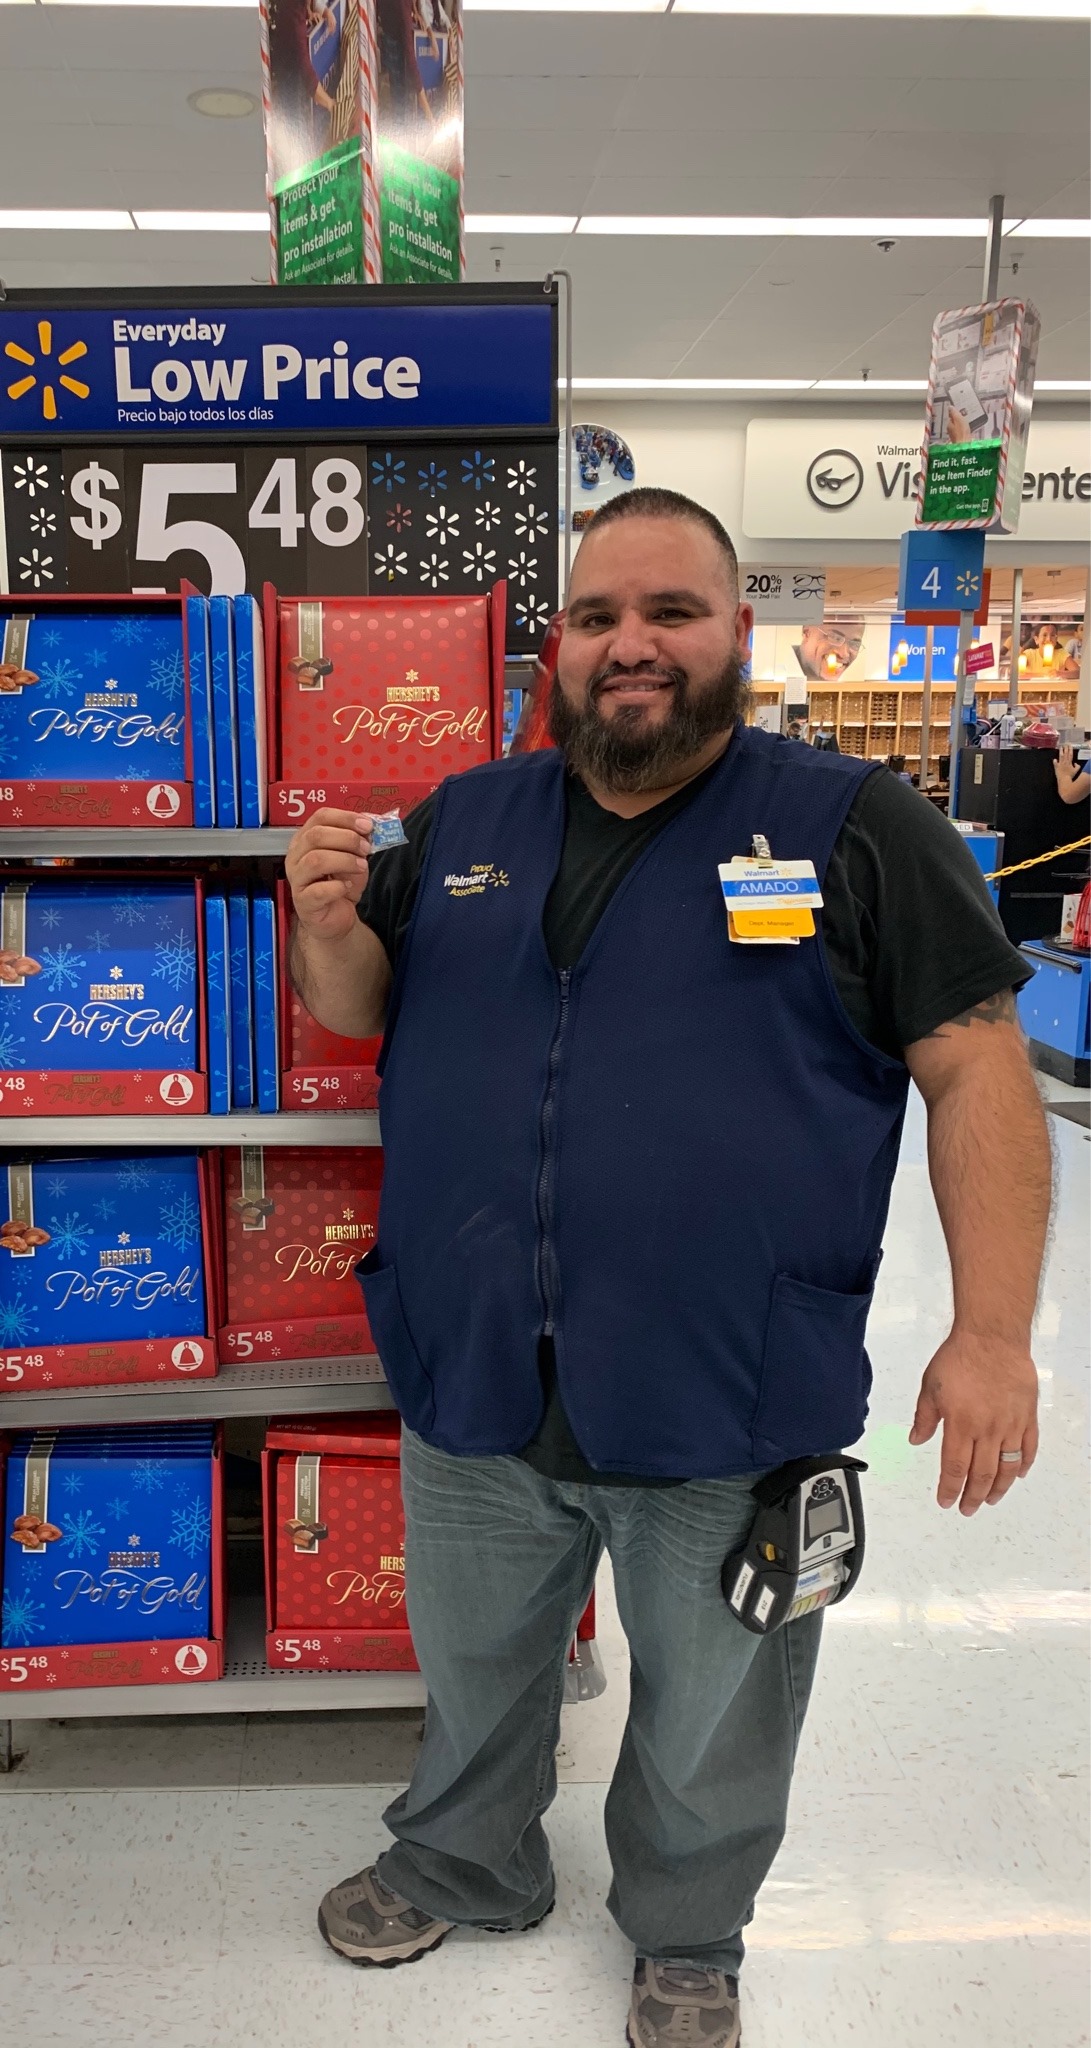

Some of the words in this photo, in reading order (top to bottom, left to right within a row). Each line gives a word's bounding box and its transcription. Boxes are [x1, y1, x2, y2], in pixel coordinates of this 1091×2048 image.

[282, 178, 317, 207] Protect
[318, 165, 339, 193] your
[283, 213, 308, 236] items
[310, 204, 318, 222] &
[320, 196, 336, 222] get
[388, 190, 413, 213] items
[414, 200, 422, 218] &
[423, 210, 438, 227] get
[284, 247, 299, 268] pro
[301, 220, 353, 255] installation
[389, 221, 405, 238] pro
[406, 224, 453, 261] installation
[284, 272, 294, 282] Ask
[294, 268, 301, 278] an
[301, 257, 327, 274] Associate
[326, 252, 335, 263] for
[389, 242, 399, 254] Ask
[406, 250, 430, 269] Associate
[429, 261, 437, 272] for
[113, 318, 226, 347] Everyday
[113, 346, 248, 403] Low
[262, 340, 421, 400] Price
[117, 408, 156, 422] Precio
[159, 407, 187, 424] bajo
[189, 407, 225, 421] todos
[228, 407, 246, 420] los
[248, 406, 274, 420] días
[931, 472, 945, 482] Use
[947, 470, 965, 480] Item
[967, 468, 993, 478] Finder
[932, 458, 949, 469] Find
[951, 457, 960, 467] it,
[961, 456, 978, 466] fast.
[930, 485, 938, 495] in
[939, 484, 951, 494] the
[953, 484, 970, 495] app.
[1021, 466, 1091, 500] ente
[770, 585, 781, 593] off
[921, 566, 941, 599] 4
[84, 693, 138, 707] HERSHEY'S
[387, 686, 440, 702] HERSHEY'S
[28, 708, 102, 742] Pot
[91, 720, 116, 743] of
[113, 712, 185, 747] Gold
[333, 703, 407, 743] Pot
[397, 717, 421, 742] of
[418, 706, 488, 746] Gold
[444, 872, 489, 887] Walmart
[470, 863, 494, 874] Proud
[744, 869, 780, 877] Walmart
[740, 881, 799, 894] AMADO
[89, 984, 144, 1000] HERSHEY'S
[33, 1002, 110, 1042] Pot
[99, 1016, 124, 1042] of
[121, 1005, 193, 1047] Gold
[5, 1077, 25, 1090] 48
[99, 1248, 152, 1267] HERSHEY'S
[275, 1242, 344, 1282] Pot
[336, 1254, 355, 1280] of
[46, 1267, 119, 1310] Pot
[110, 1280, 133, 1307] of
[132, 1265, 199, 1310] Gold
[54, 1569, 126, 1609] Pot
[116, 1583, 140, 1610] of
[137, 1572, 207, 1614] Gold
[326, 1570, 399, 1605] Pot
